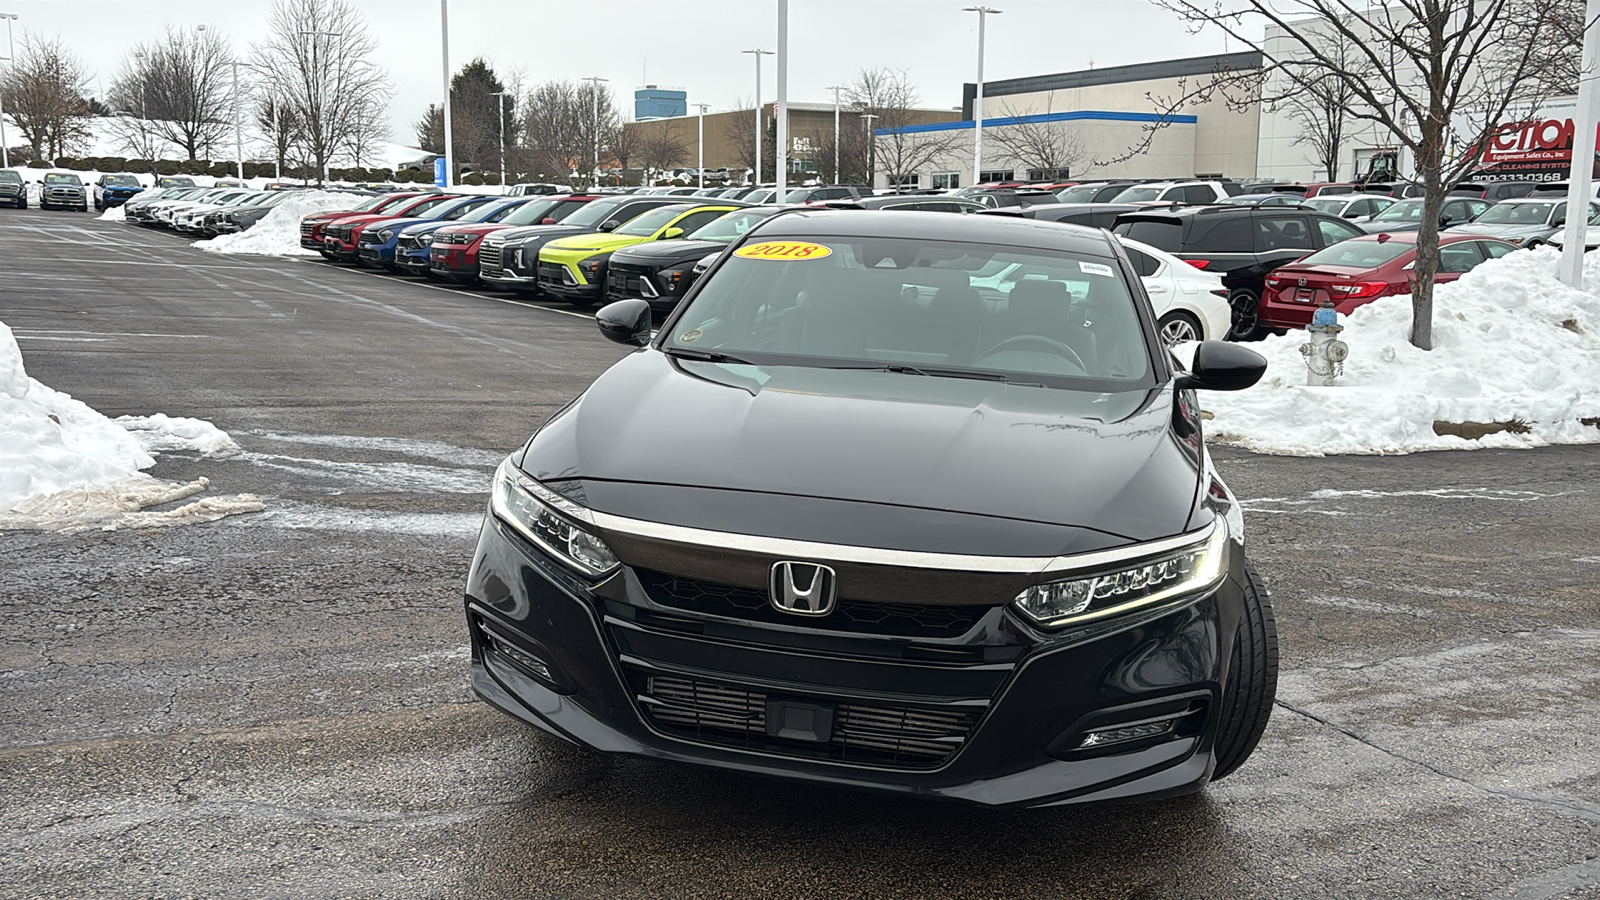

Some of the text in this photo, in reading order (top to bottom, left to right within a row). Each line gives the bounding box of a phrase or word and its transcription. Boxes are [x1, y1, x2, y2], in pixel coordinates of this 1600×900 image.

[1493, 153, 1525, 161] Equipment
[1542, 151, 1554, 159] Co.,
[1502, 163, 1540, 171] CLEANING
[1472, 173, 1561, 181] 800-333-0368
[745, 245, 818, 257] 2018
